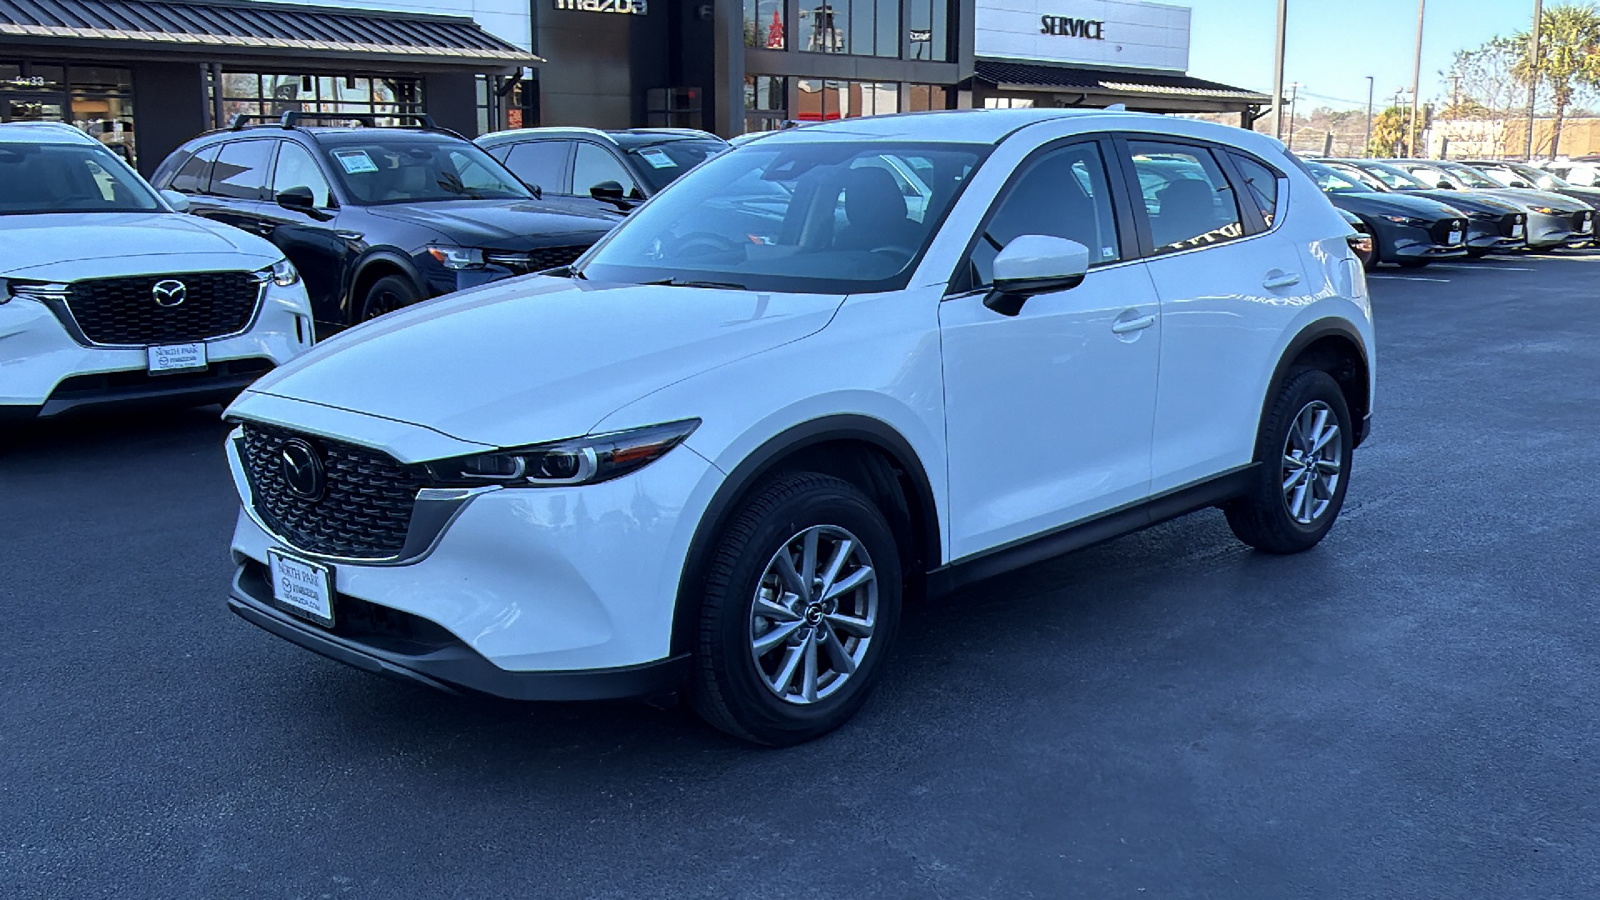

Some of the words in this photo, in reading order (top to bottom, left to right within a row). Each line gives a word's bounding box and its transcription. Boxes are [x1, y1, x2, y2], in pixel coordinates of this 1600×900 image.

[1040, 15, 1105, 40] SERVICE
[278, 563, 301, 580] NORTH
[302, 571, 319, 586] PARK
